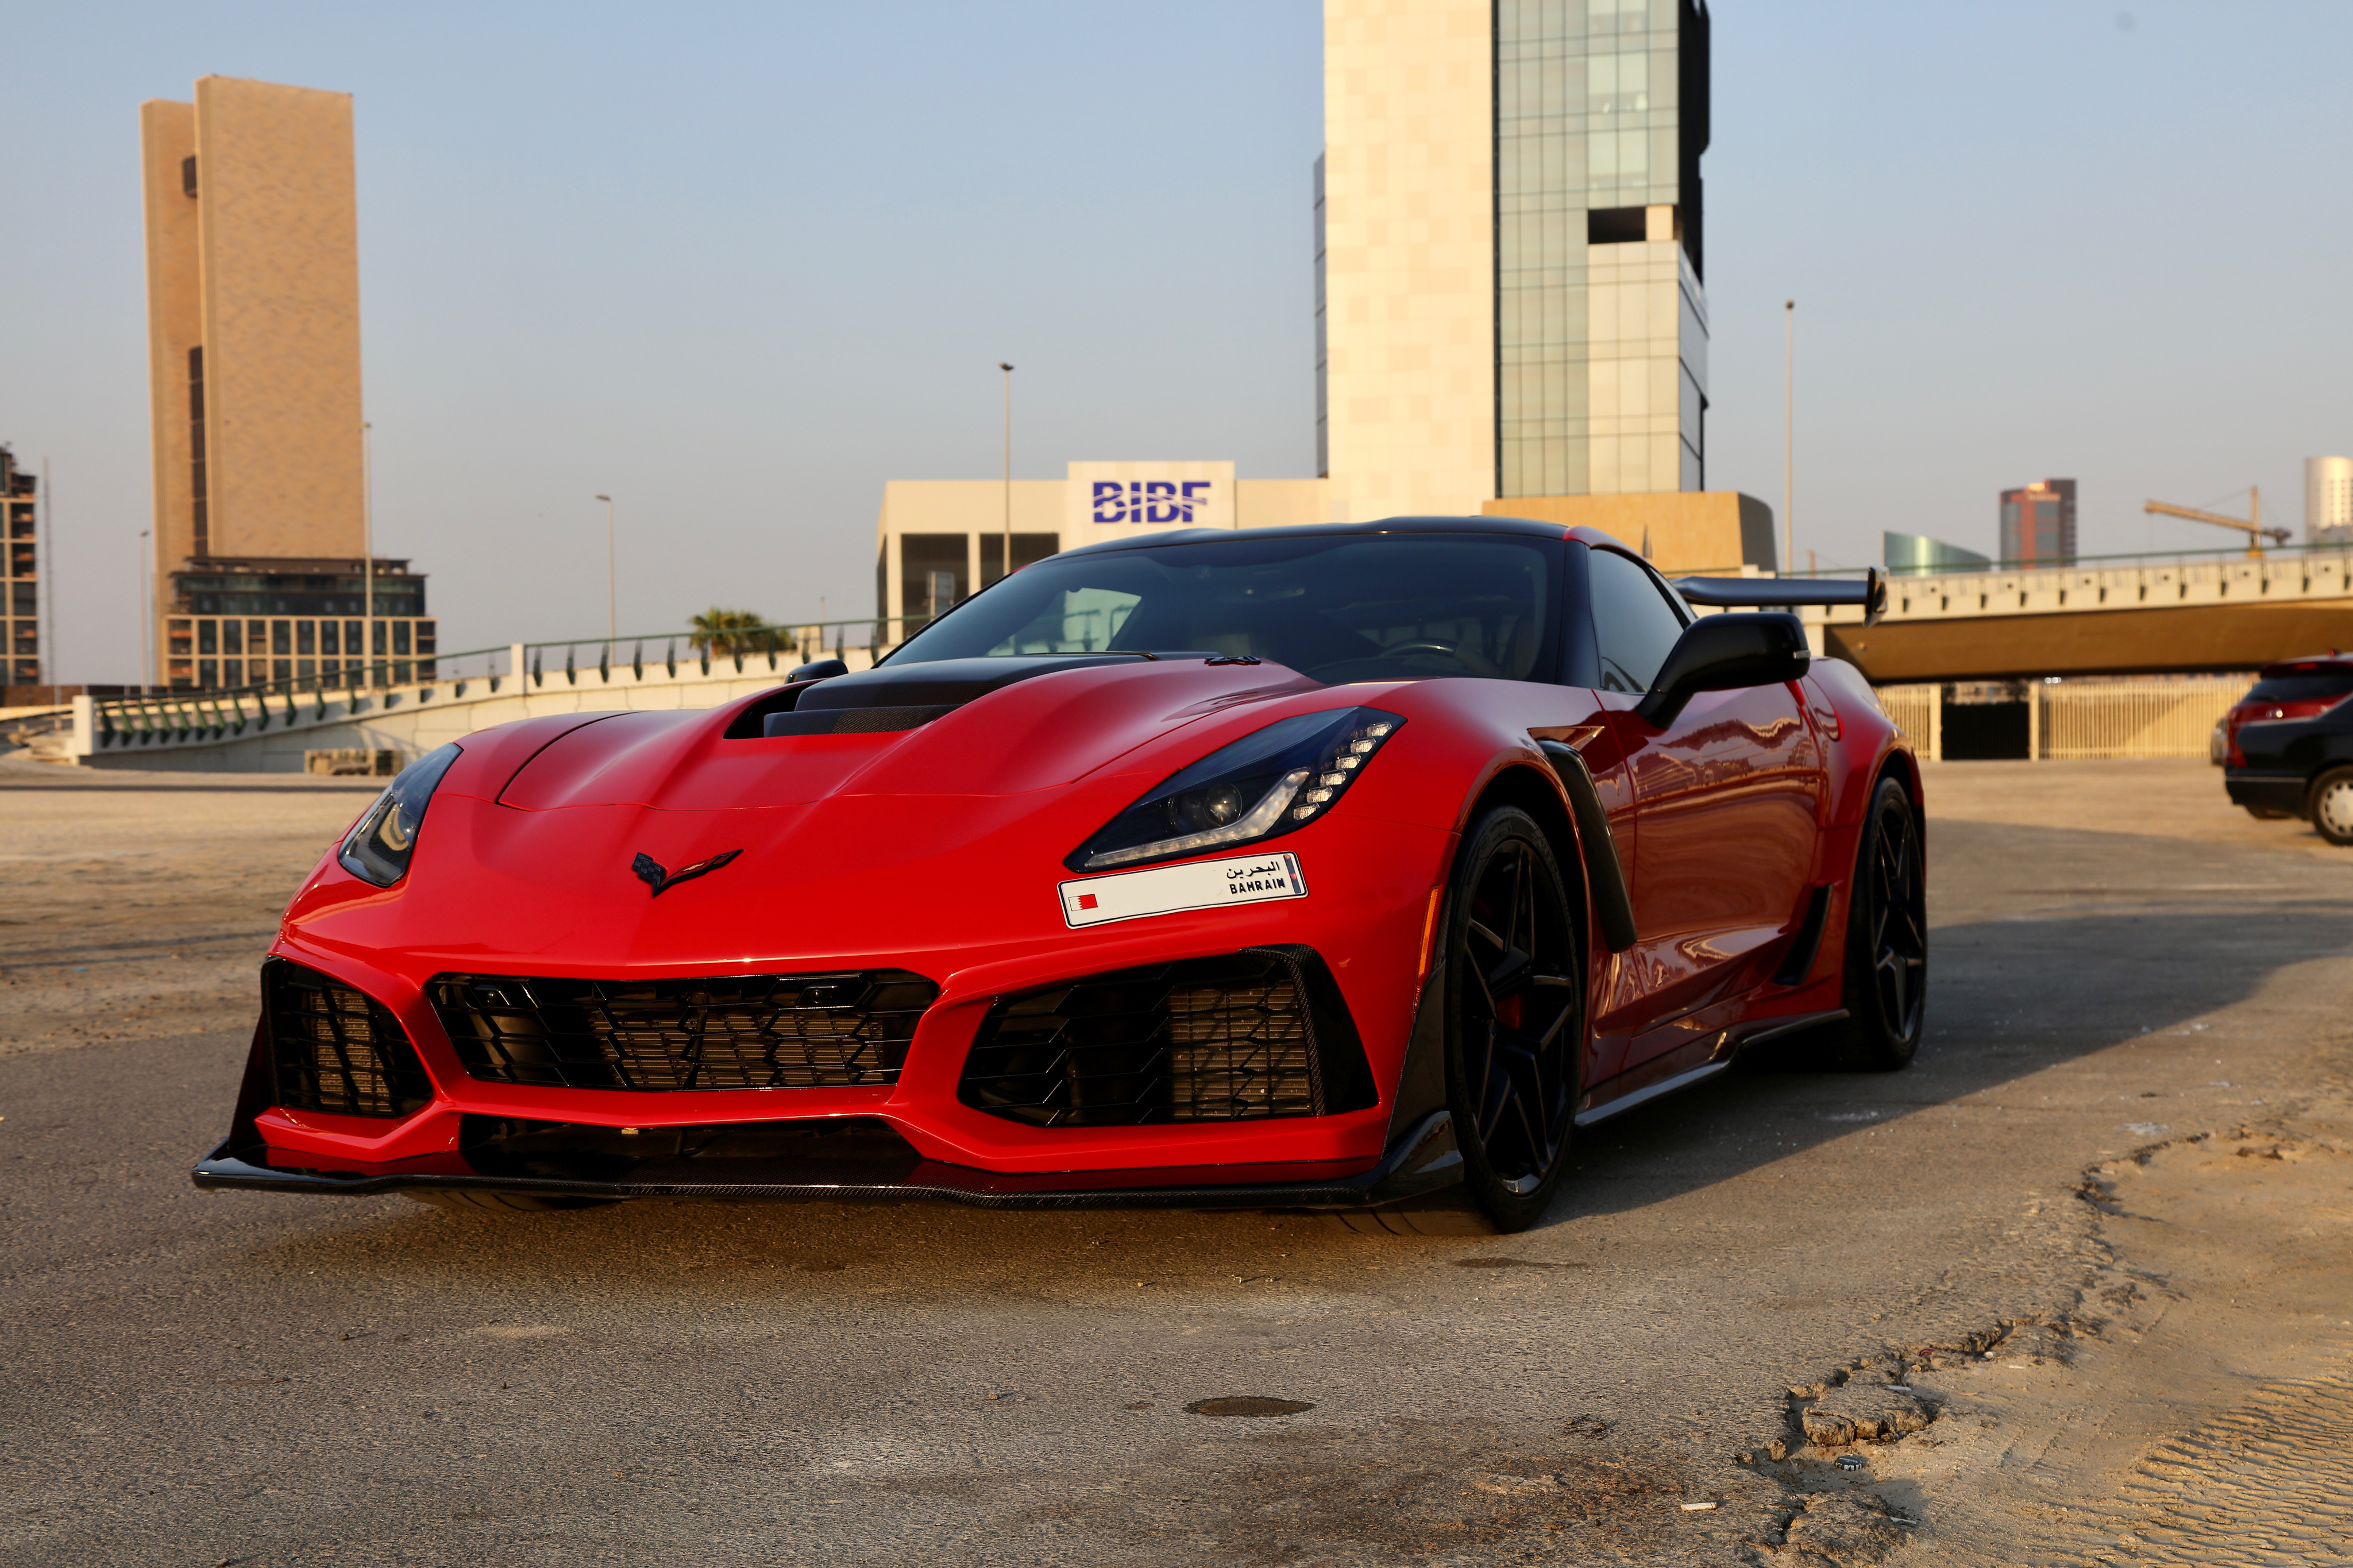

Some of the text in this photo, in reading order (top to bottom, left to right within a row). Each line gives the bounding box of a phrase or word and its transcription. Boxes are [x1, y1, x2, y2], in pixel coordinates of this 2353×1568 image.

[1093, 481, 1210, 523] BIBF
[1226, 861, 1280, 879] البحرين
[1229, 878, 1286, 894] BAHRAIN
